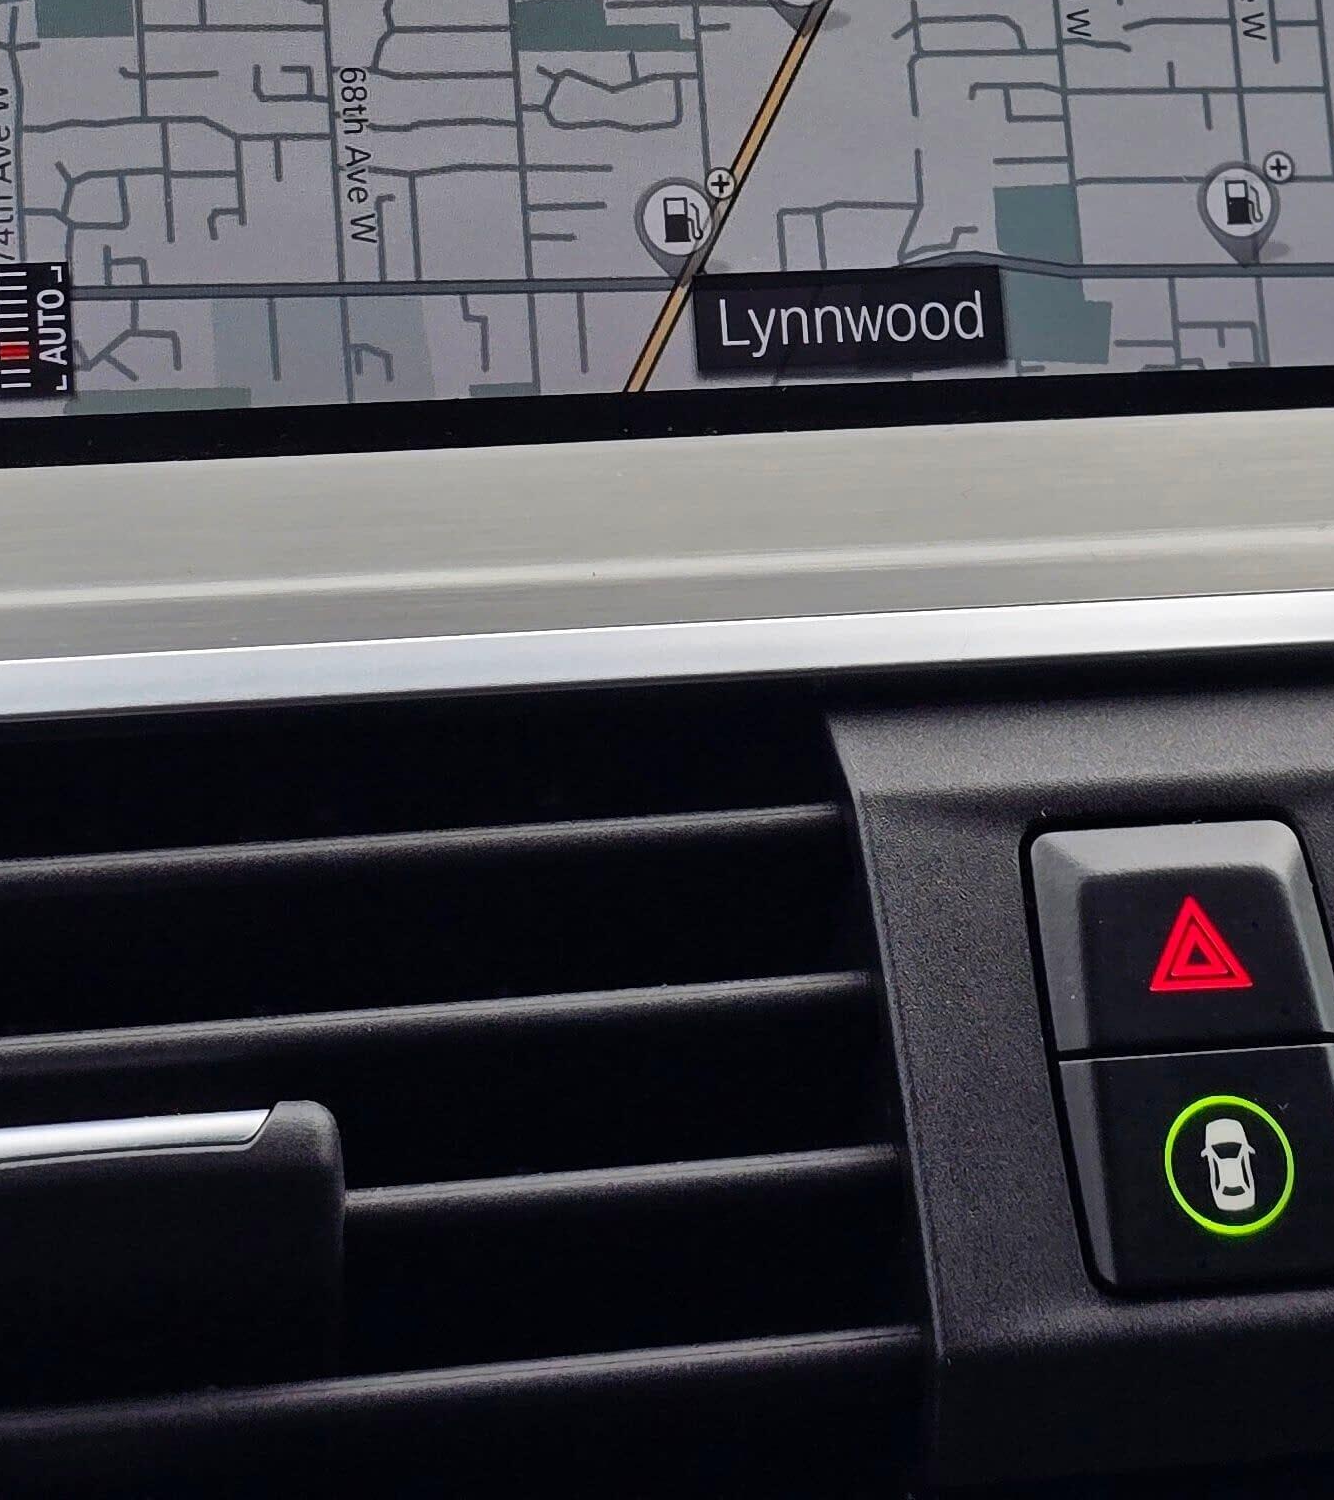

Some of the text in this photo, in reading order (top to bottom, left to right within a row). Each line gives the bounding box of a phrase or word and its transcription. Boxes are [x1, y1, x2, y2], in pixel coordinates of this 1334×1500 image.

[1066, 8, 1092, 37] W
[1241, 11, 1267, 40] W
[340, 67, 377, 243] 68th Ave W
[37, 288, 67, 366] AUTO
[719, 290, 984, 357] Lynnwood
